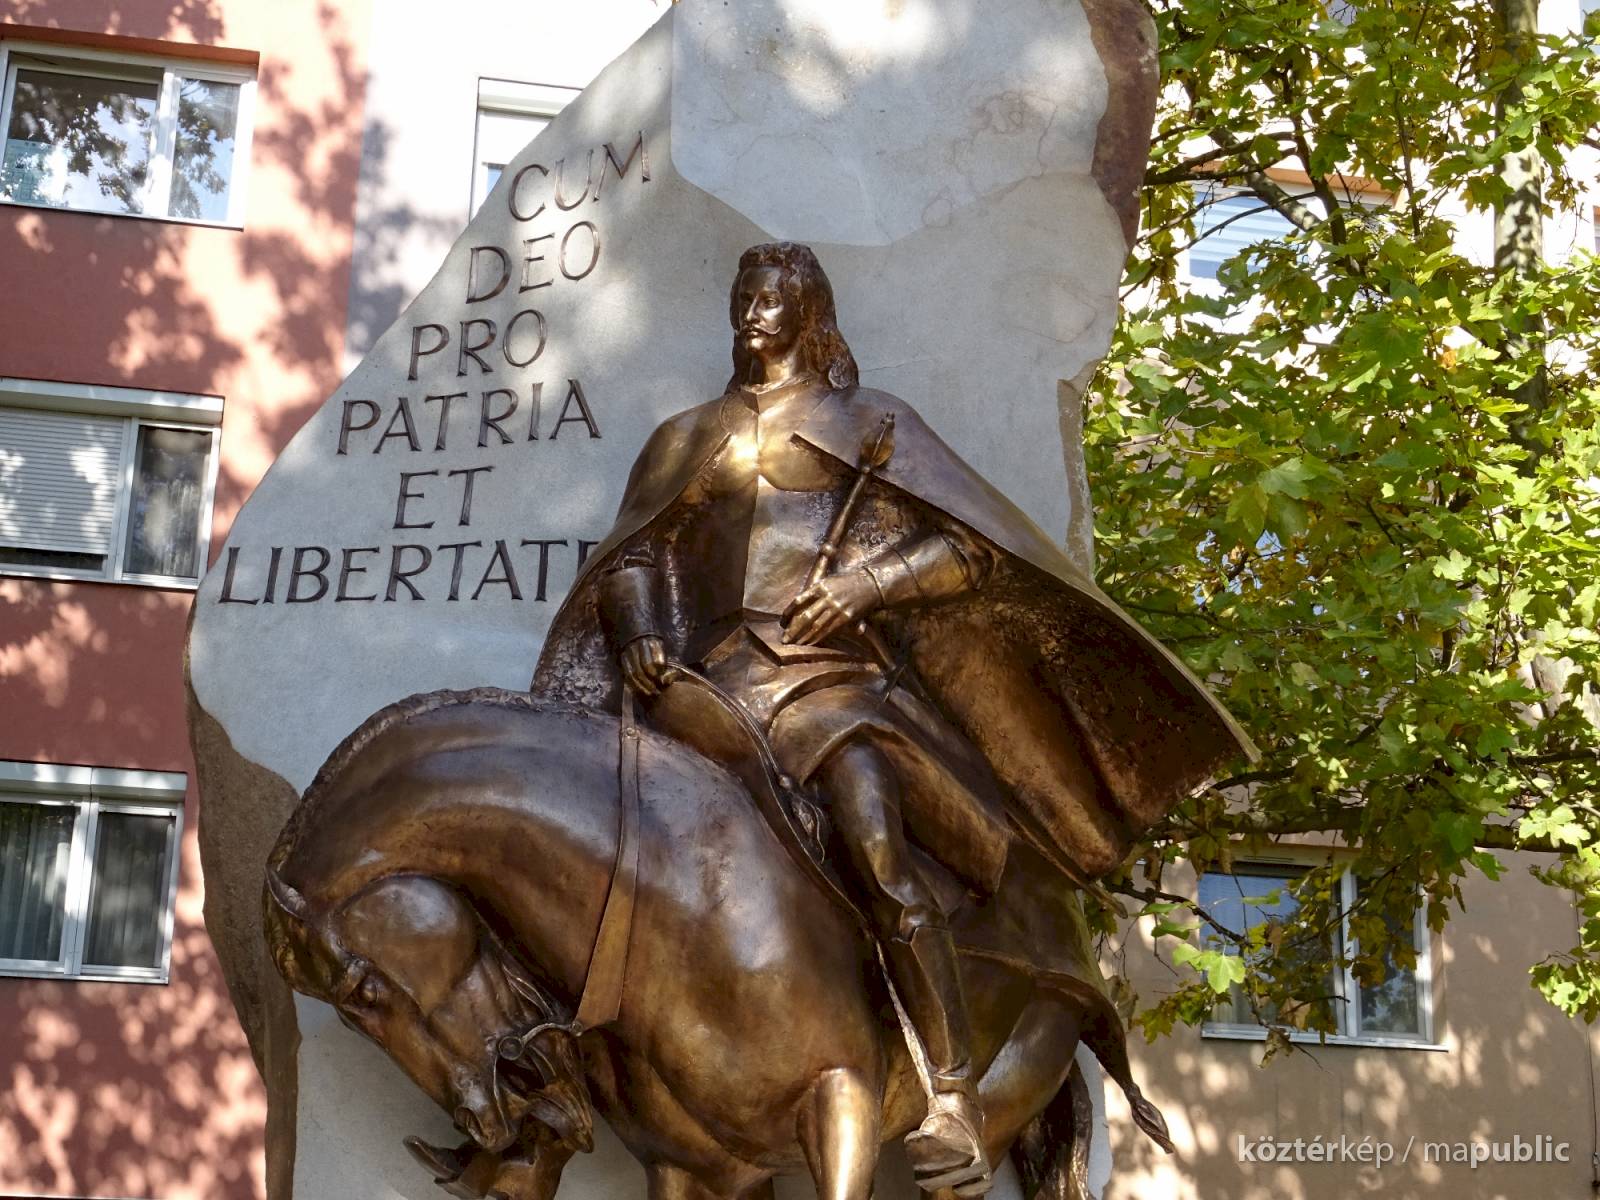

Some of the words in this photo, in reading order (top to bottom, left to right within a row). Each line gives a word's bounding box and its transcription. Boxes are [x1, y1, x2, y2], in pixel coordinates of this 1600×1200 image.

[508, 130, 652, 222] CUM
[466, 220, 601, 304] DEO
[407, 309, 548, 381] PRO
[336, 378, 602, 455] PATRIA
[393, 465, 496, 529] ET
